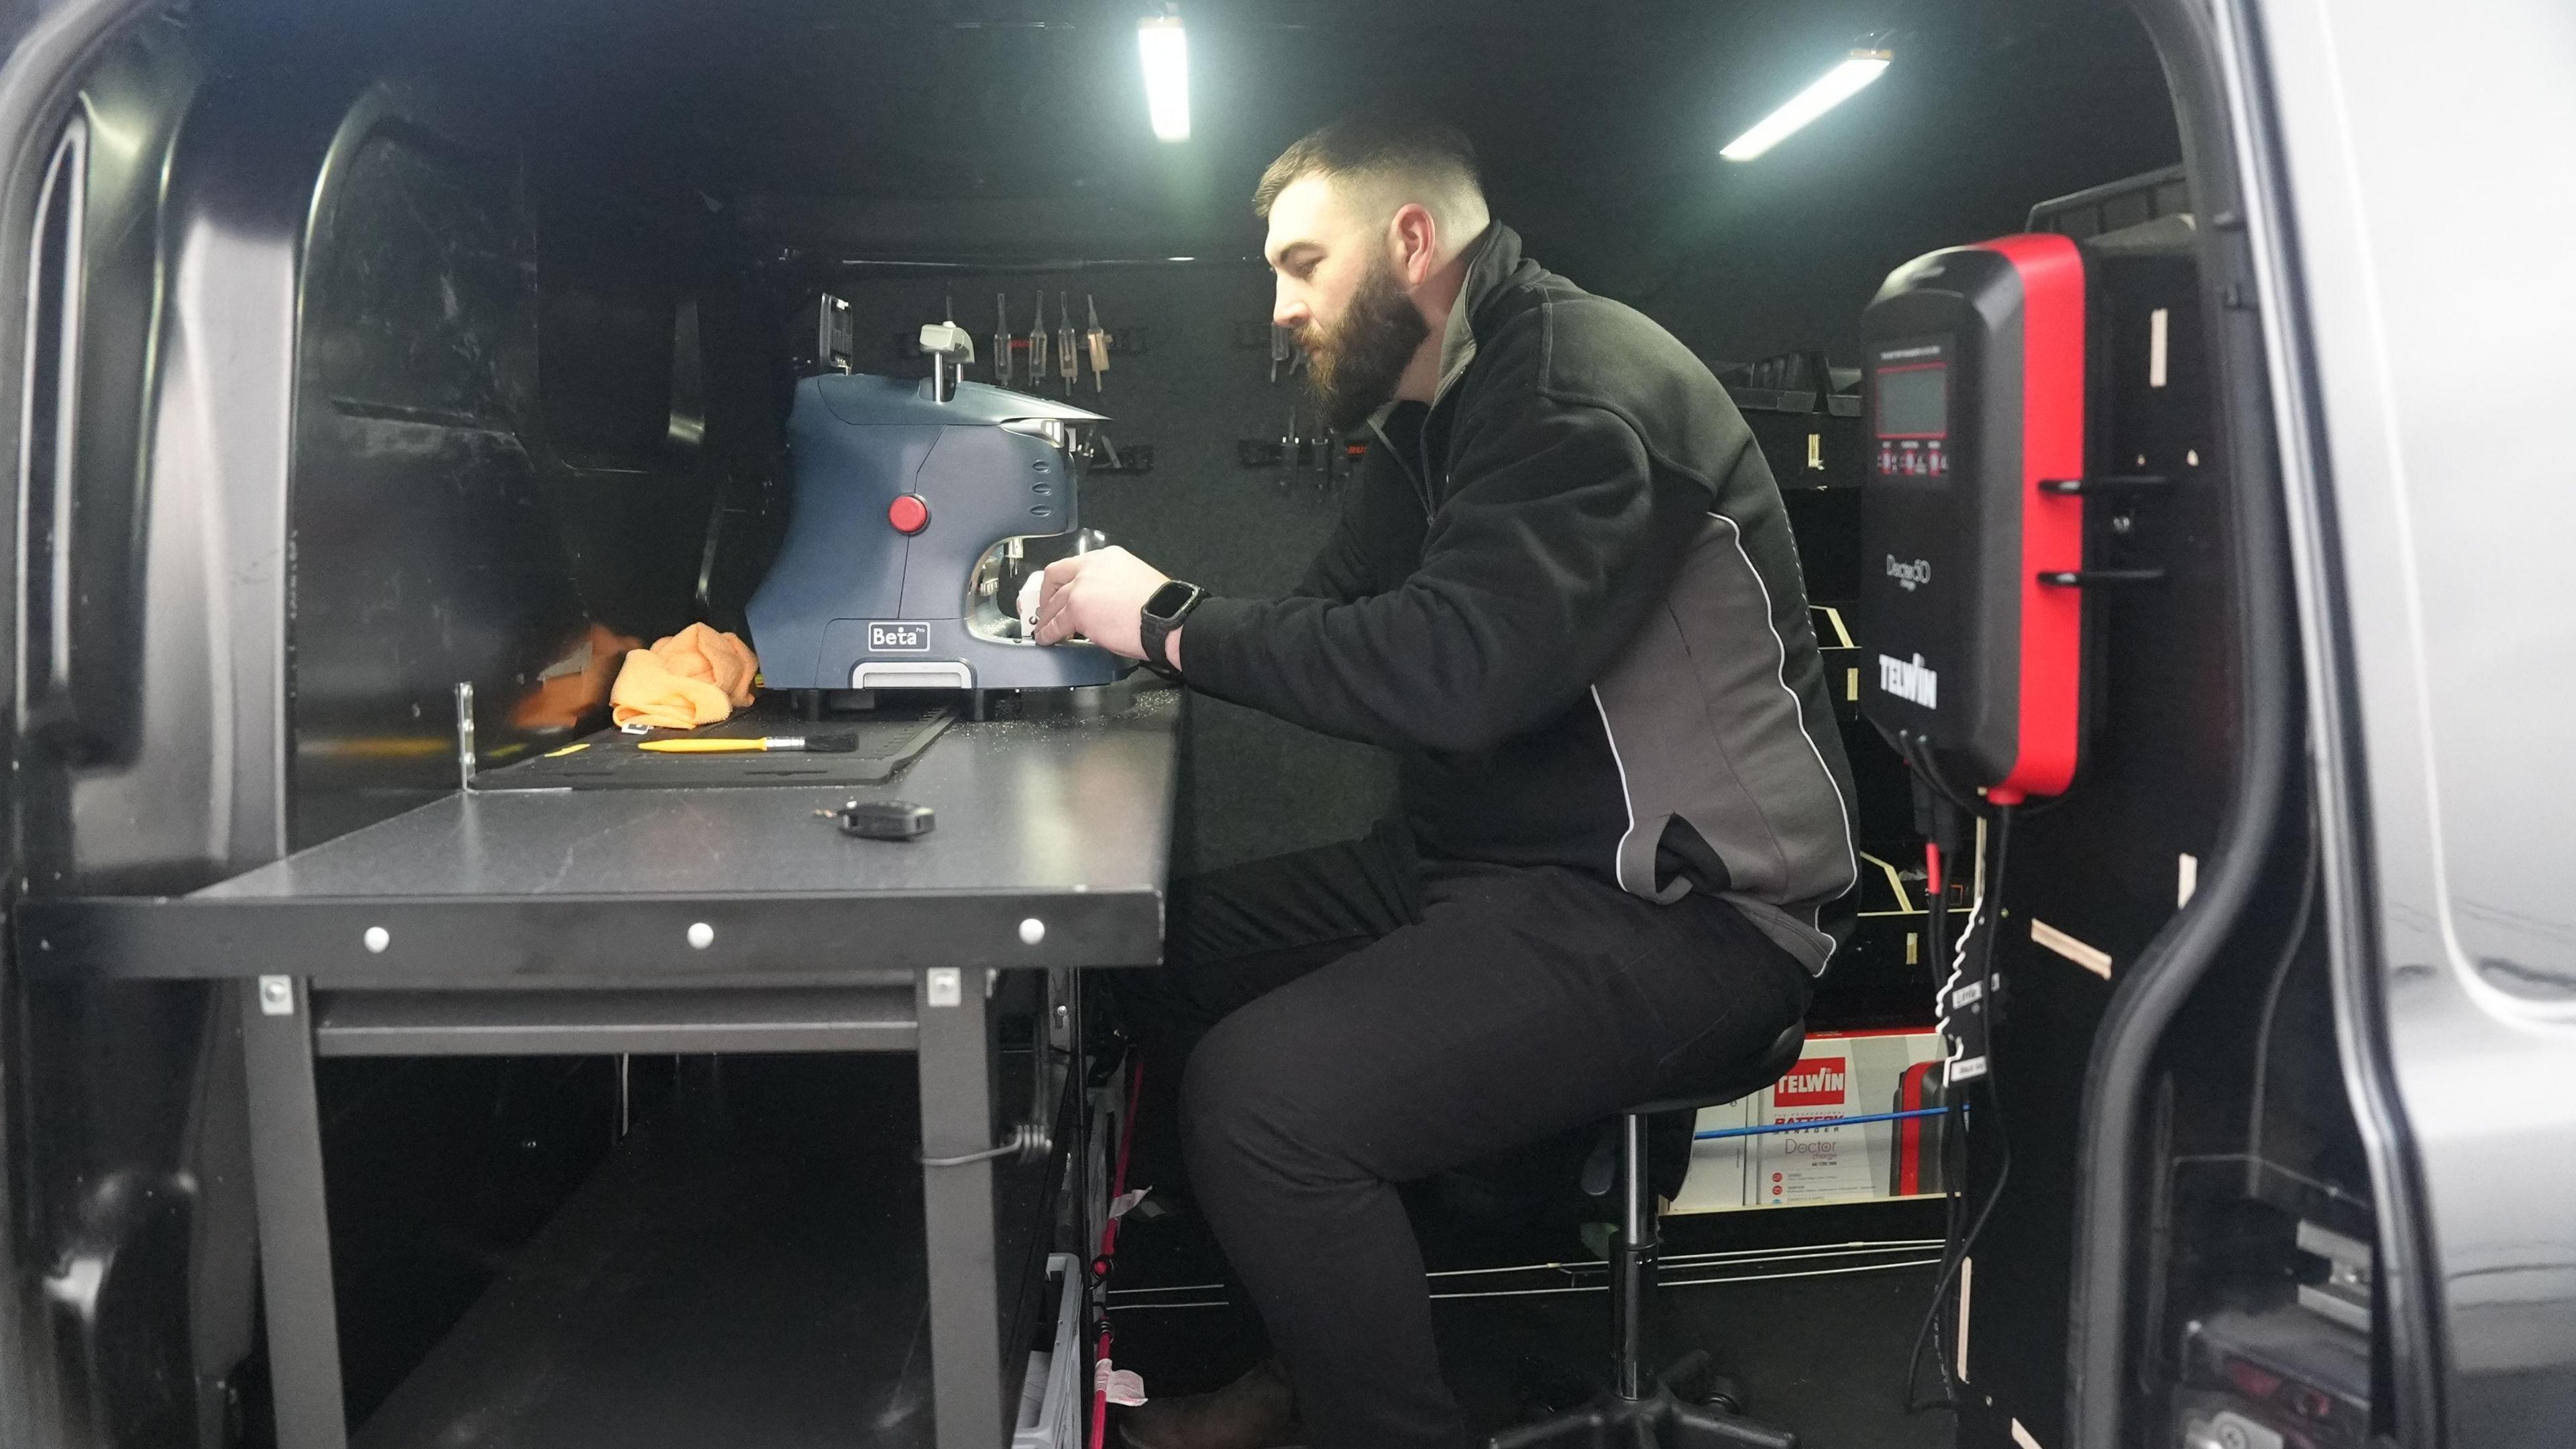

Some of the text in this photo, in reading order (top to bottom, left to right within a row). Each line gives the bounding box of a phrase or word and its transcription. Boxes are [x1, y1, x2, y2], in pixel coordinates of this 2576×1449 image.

[873, 627, 917, 645] Beta
[1879, 653, 1937, 710] TELWIN
[1778, 1067, 1845, 1094] TELWIN
[1785, 1138, 1837, 1154] Doctor
